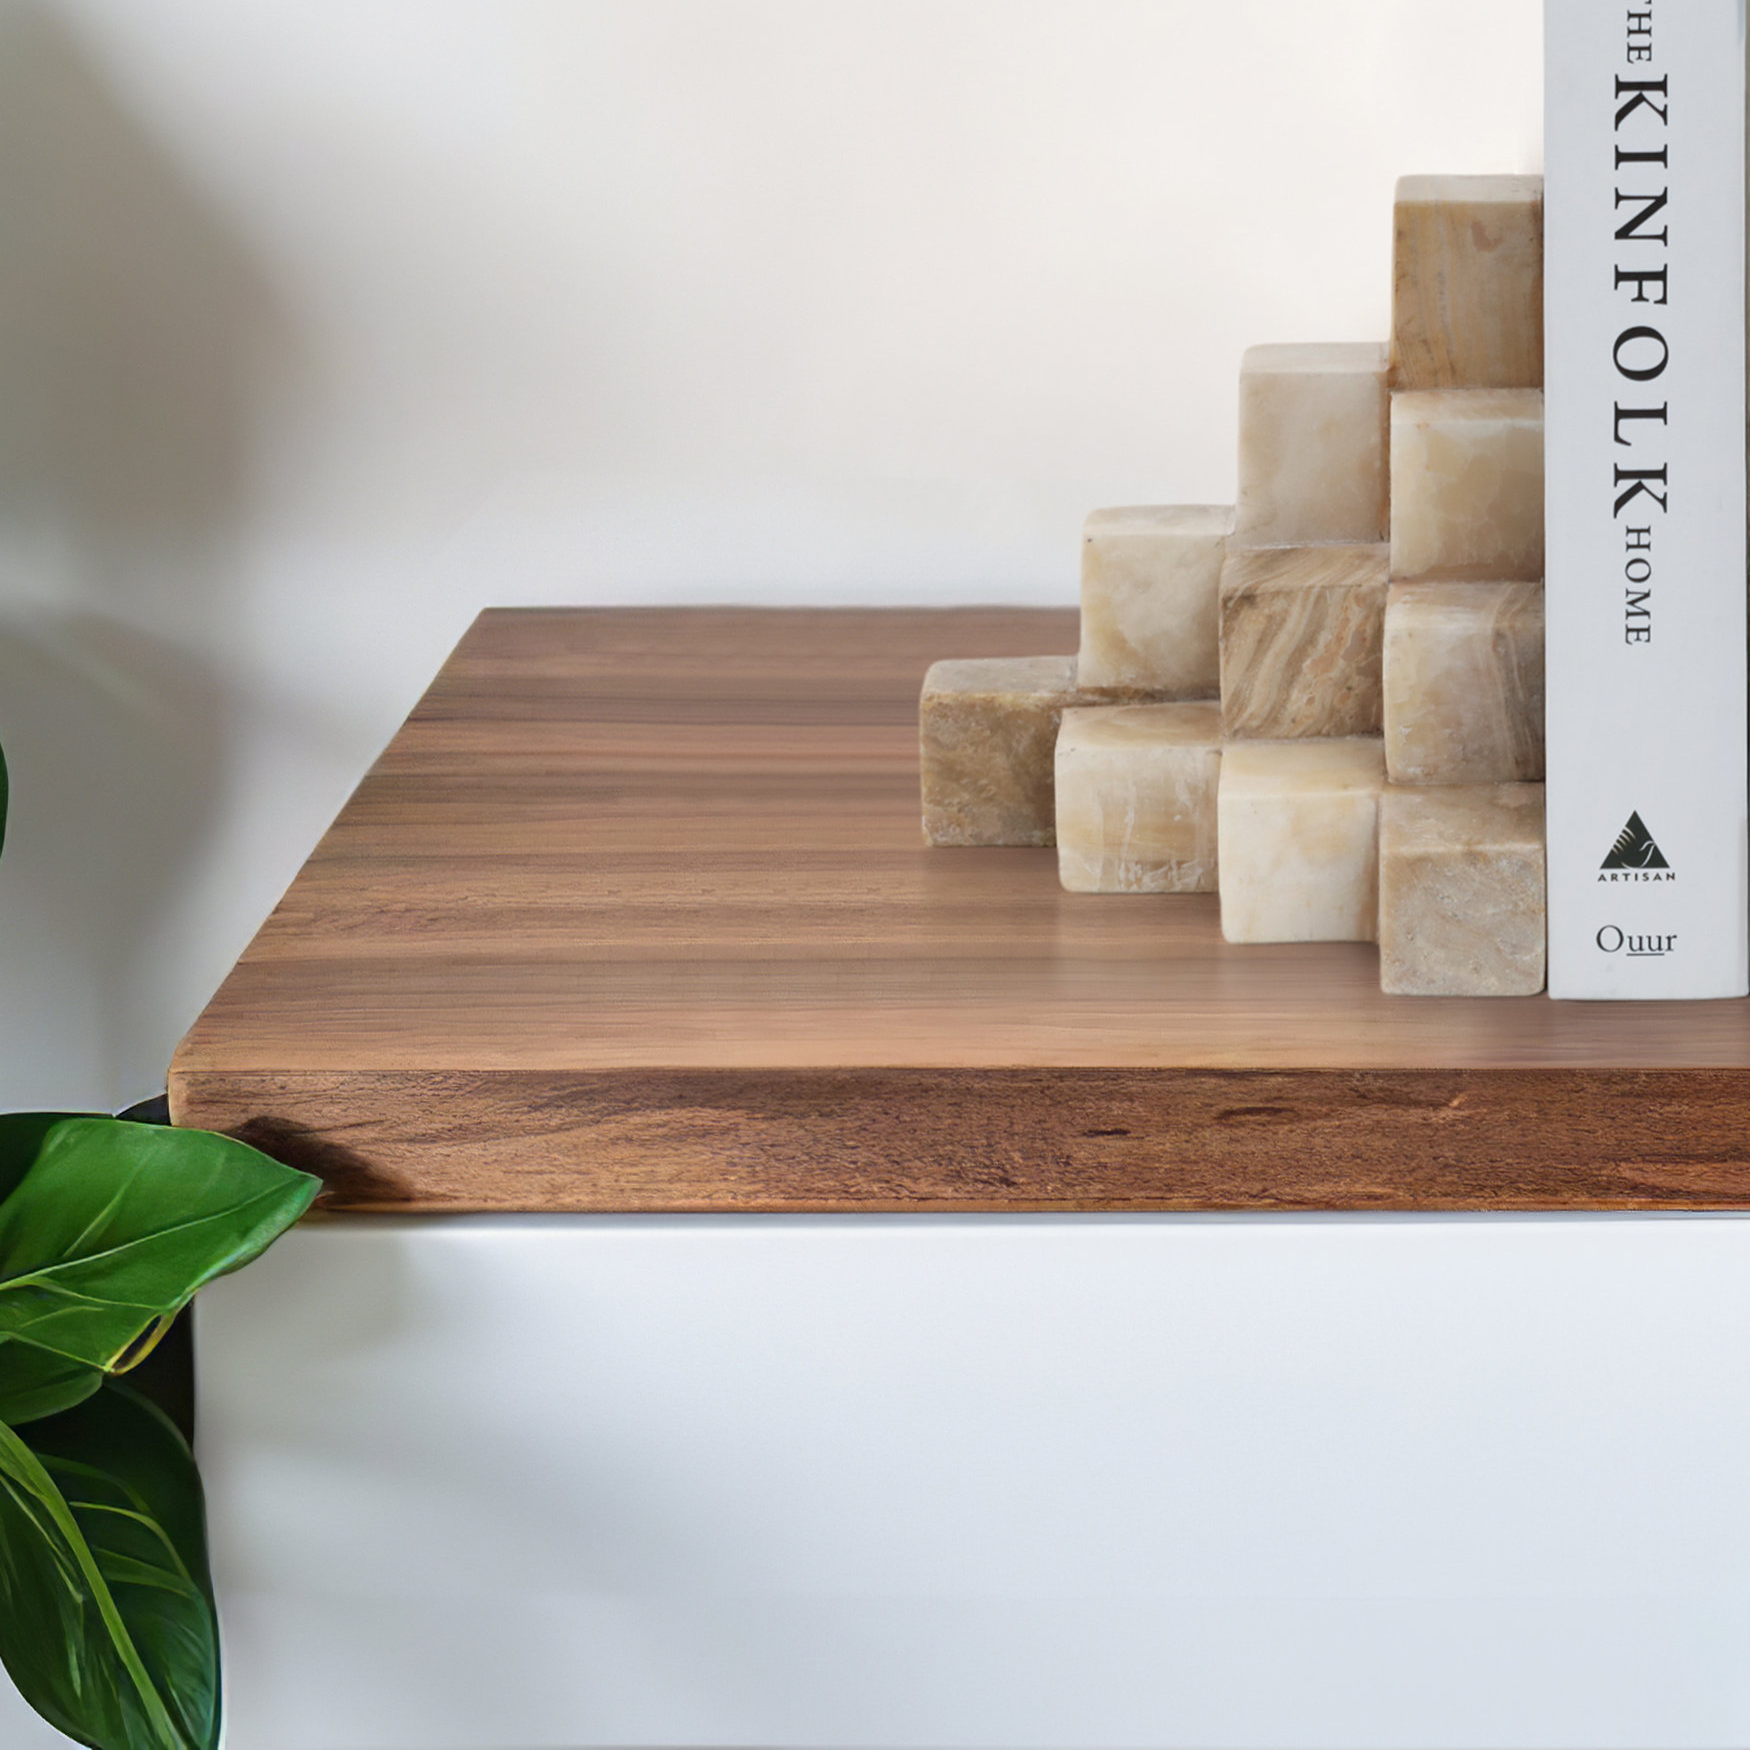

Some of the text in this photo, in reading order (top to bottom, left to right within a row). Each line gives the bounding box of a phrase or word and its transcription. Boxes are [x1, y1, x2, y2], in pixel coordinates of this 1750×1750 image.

[1612, 72, 1669, 519] KINFOLK
[1624, 525, 1652, 646] HOME
[1597, 871, 1676, 883] ARTISAN
[1596, 924, 1678, 954] Ouur
